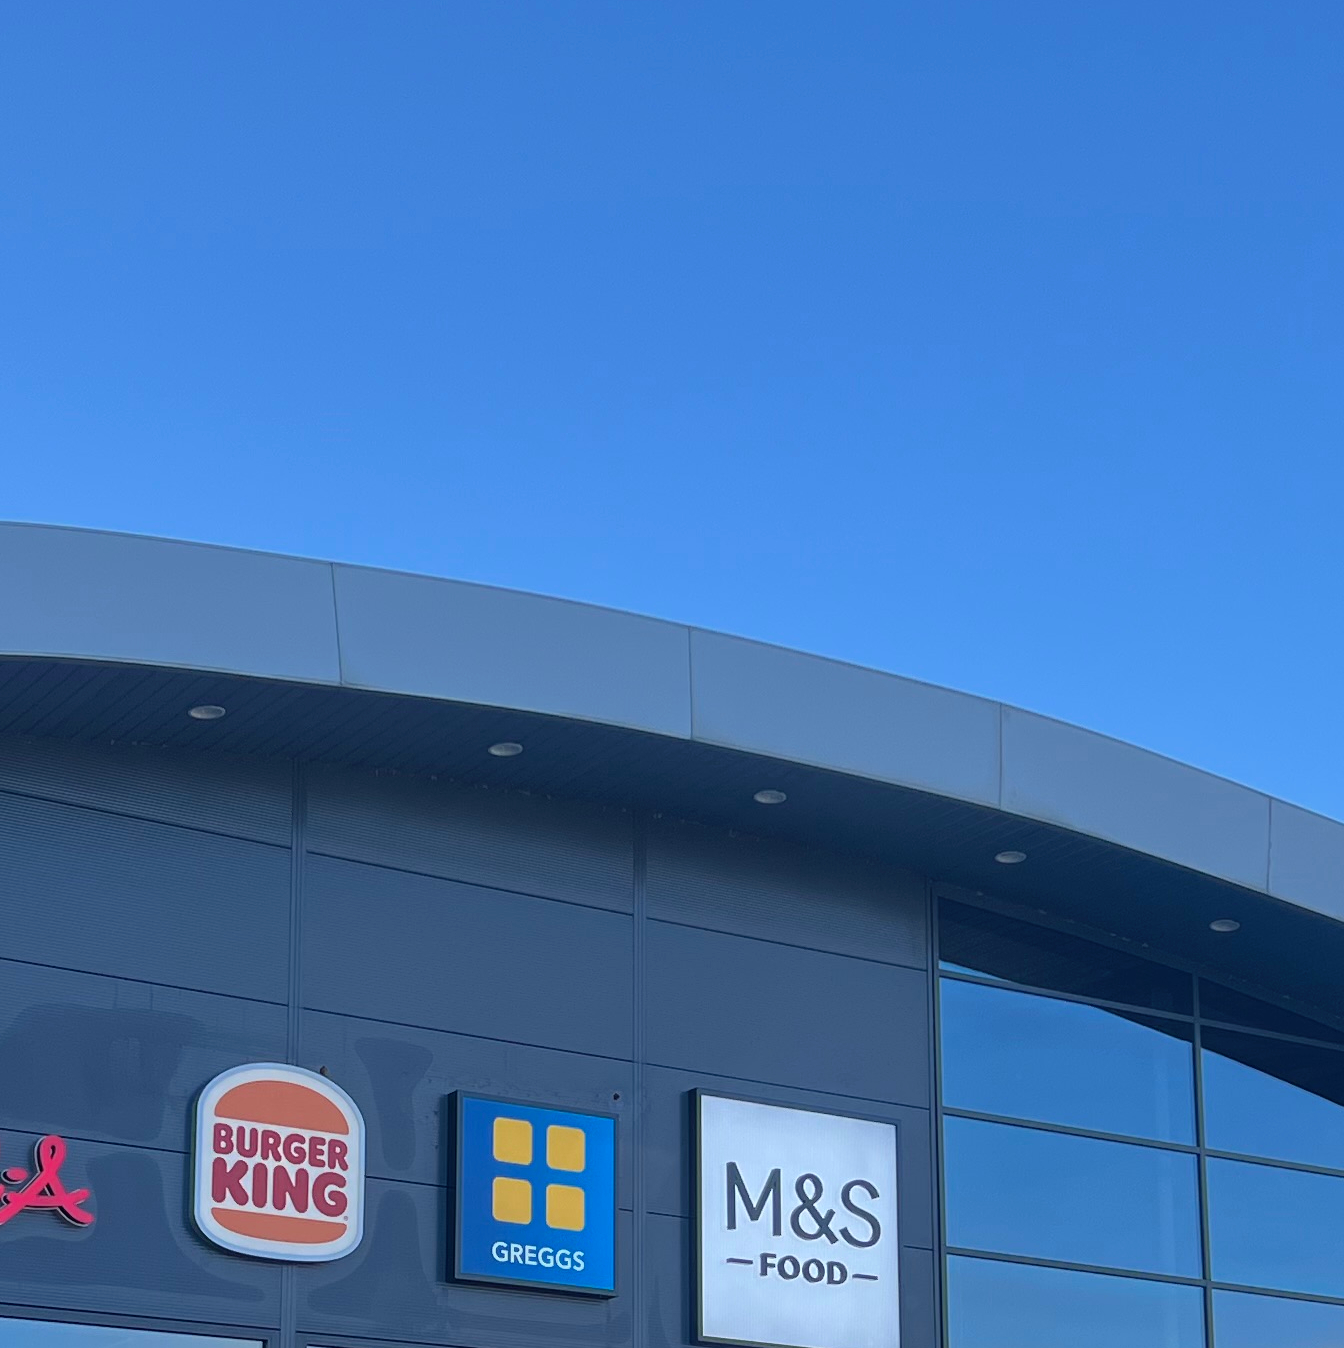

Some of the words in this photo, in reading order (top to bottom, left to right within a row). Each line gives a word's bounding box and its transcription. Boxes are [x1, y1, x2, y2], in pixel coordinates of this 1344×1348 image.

[212, 1122, 349, 1171] BURGER
[211, 1156, 348, 1217] KING
[726, 1161, 881, 1248] M&S
[492, 1241, 585, 1272] GREGGS
[759, 1252, 848, 1285] FOOD
